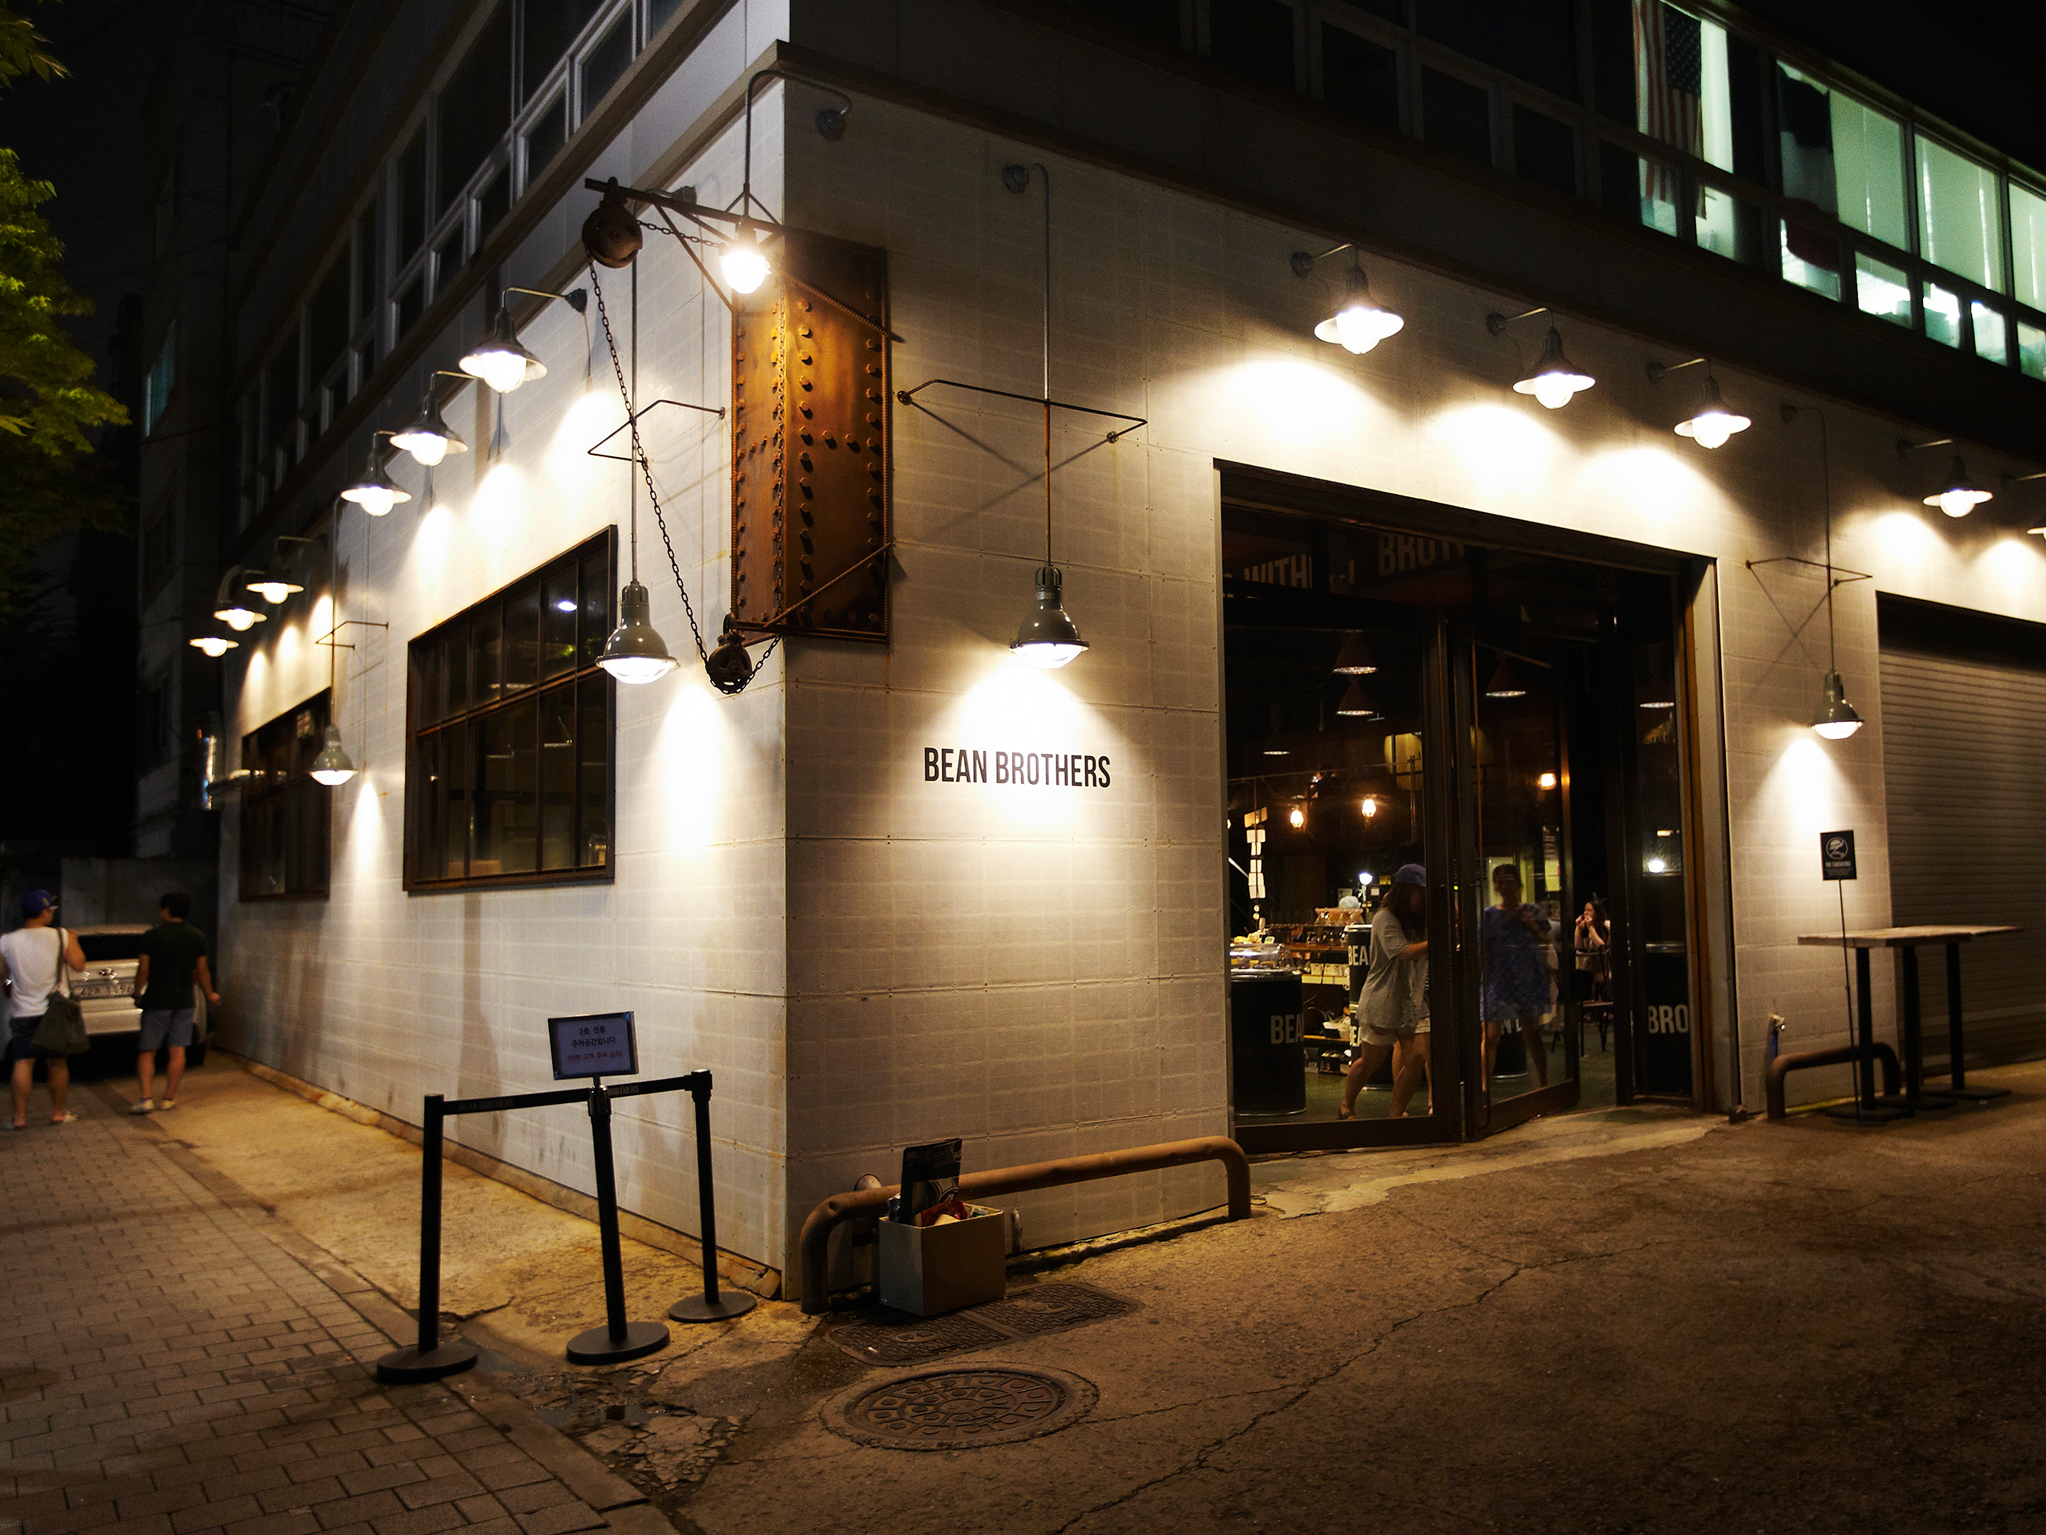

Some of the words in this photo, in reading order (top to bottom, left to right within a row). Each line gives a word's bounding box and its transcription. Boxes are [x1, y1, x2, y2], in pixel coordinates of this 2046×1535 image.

[924, 747, 987, 783] BEAN
[996, 751, 1111, 788] BROTHERS
[1348, 944, 1370, 967] BEA
